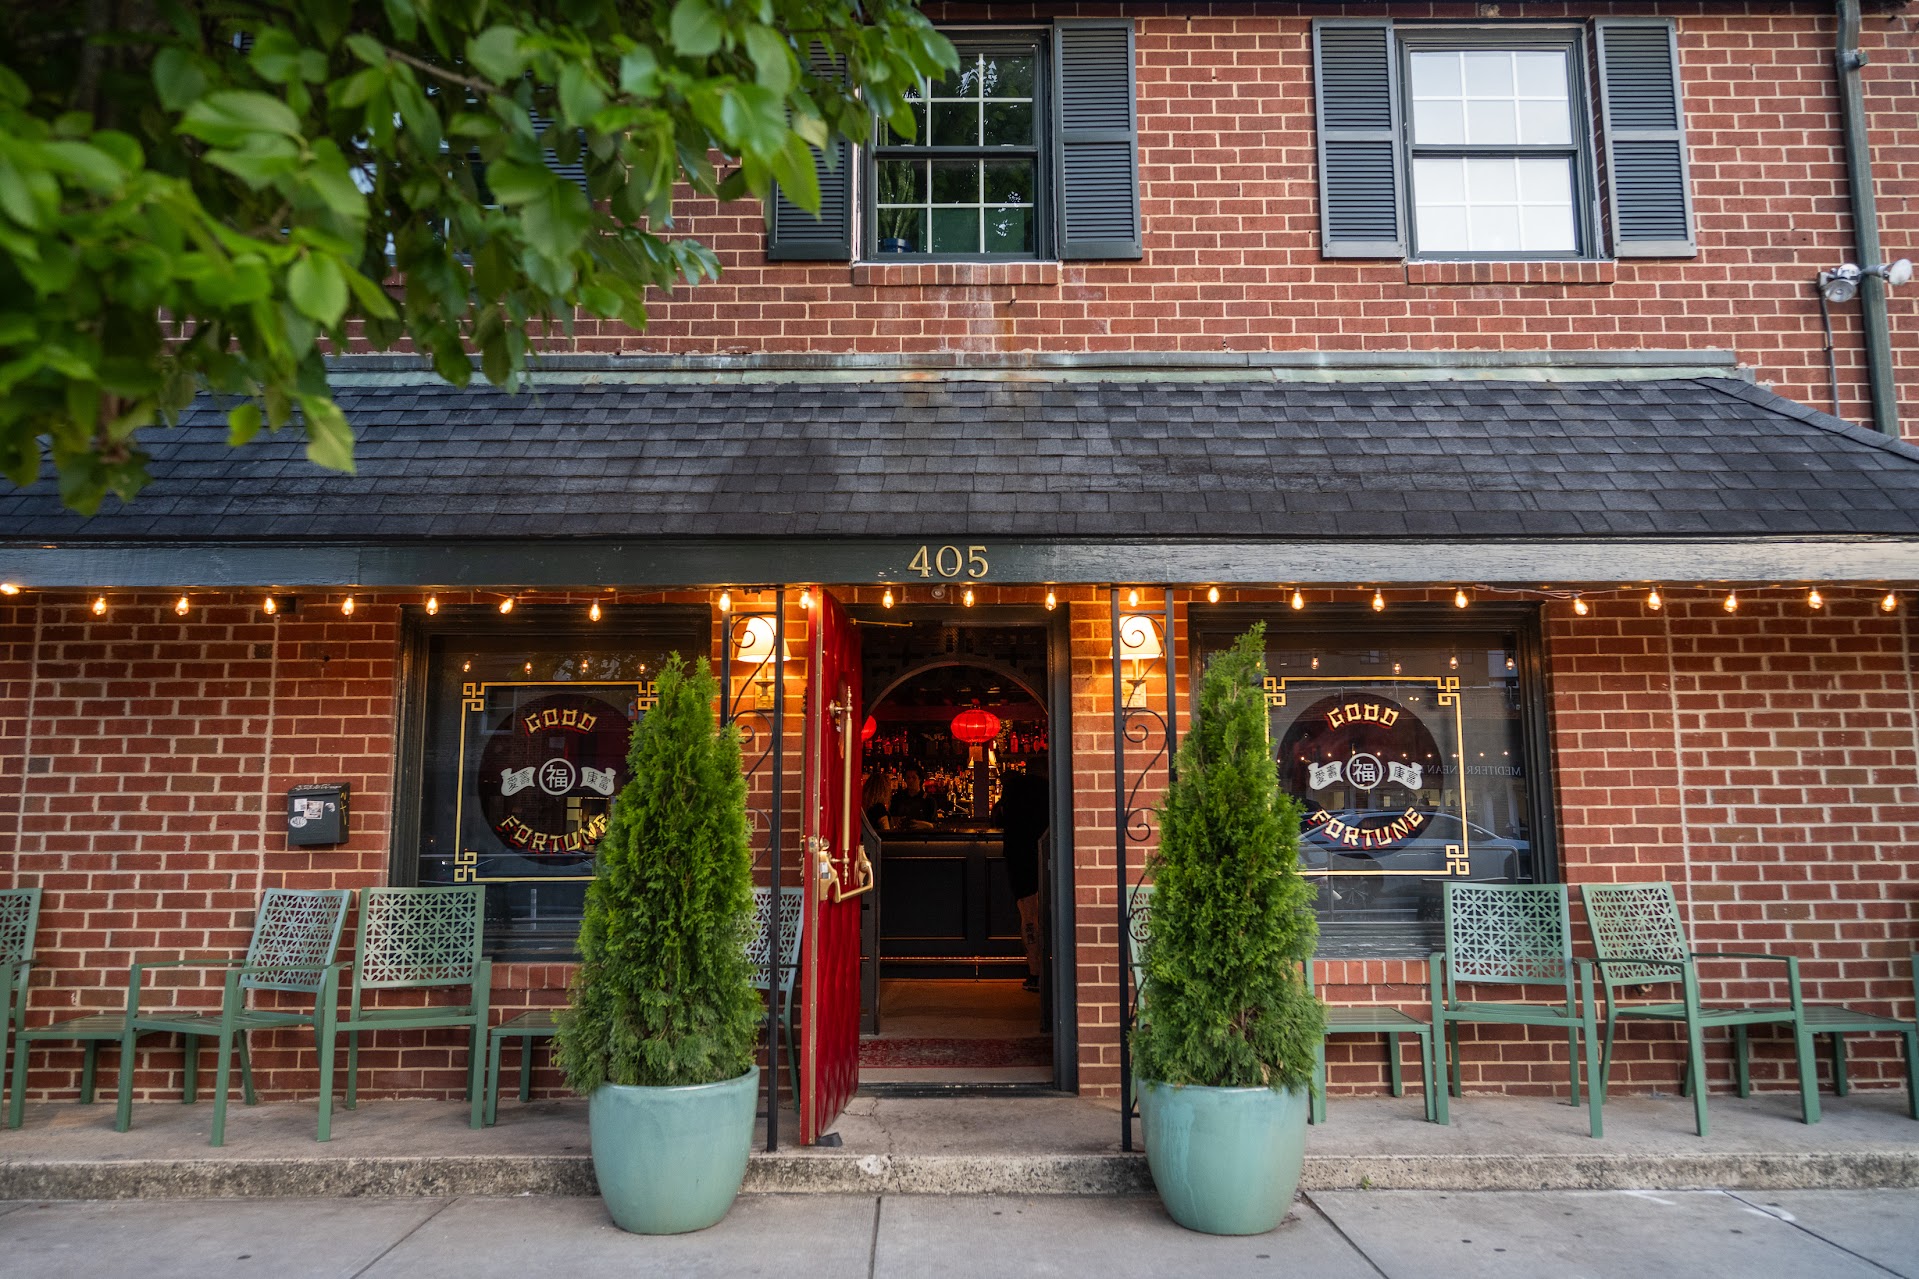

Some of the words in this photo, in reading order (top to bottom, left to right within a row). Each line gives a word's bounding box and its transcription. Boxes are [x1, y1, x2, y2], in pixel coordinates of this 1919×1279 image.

[907, 545, 989, 577] 405
[523, 708, 598, 734] GOOD
[1325, 702, 1400, 729] GOOD
[545, 764, 568, 788] 福
[1352, 758, 1377, 783] 福
[1310, 806, 1425, 847] FORTUNE
